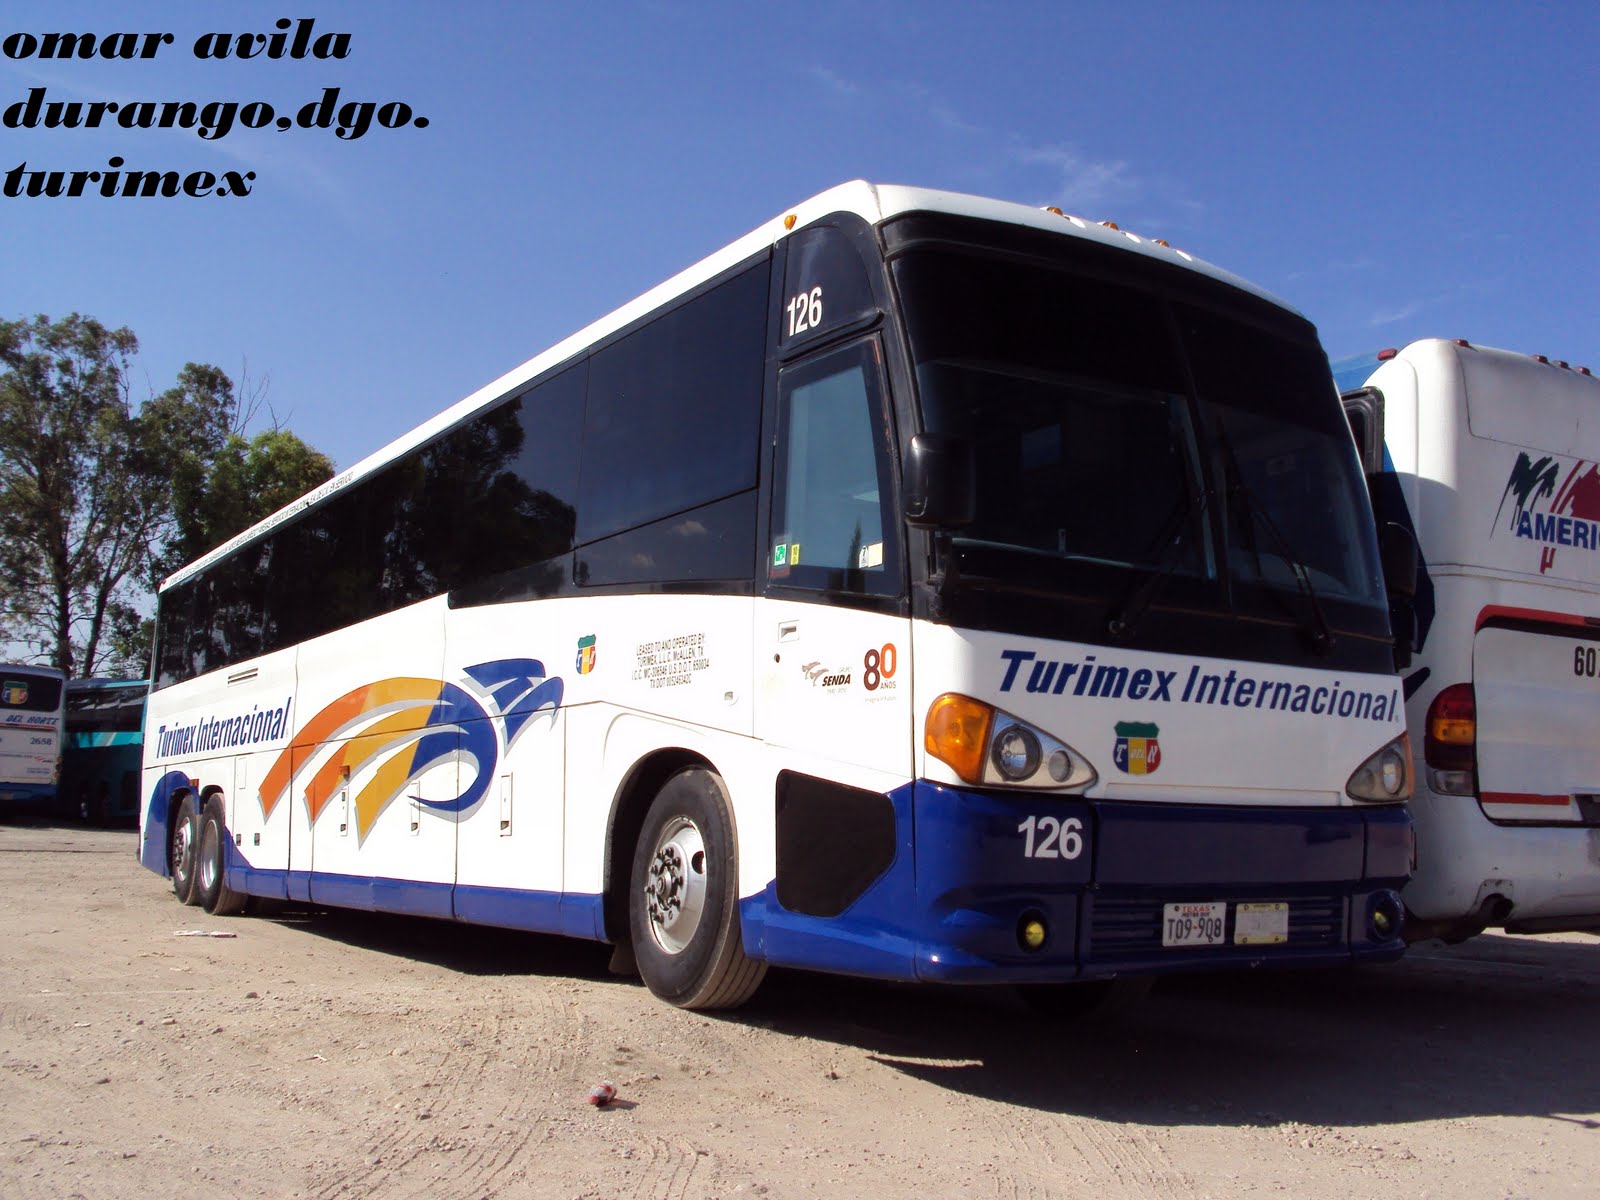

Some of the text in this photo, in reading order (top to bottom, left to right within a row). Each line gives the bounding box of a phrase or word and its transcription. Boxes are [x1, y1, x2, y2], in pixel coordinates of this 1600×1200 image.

[787, 286, 822, 336] 126
[1516, 510, 1600, 551] AMERI
[822, 674, 851, 687] SENDA
[863, 642, 897, 691] 80
[880, 680, 897, 690] AÑOS
[1000, 649, 1398, 723] Turimex Internacional
[6, 715, 59, 725] DEL NORTE
[30, 737, 52, 746] 2658
[156, 696, 292, 759] Turimex Internacional
[1018, 815, 1083, 860] 126
